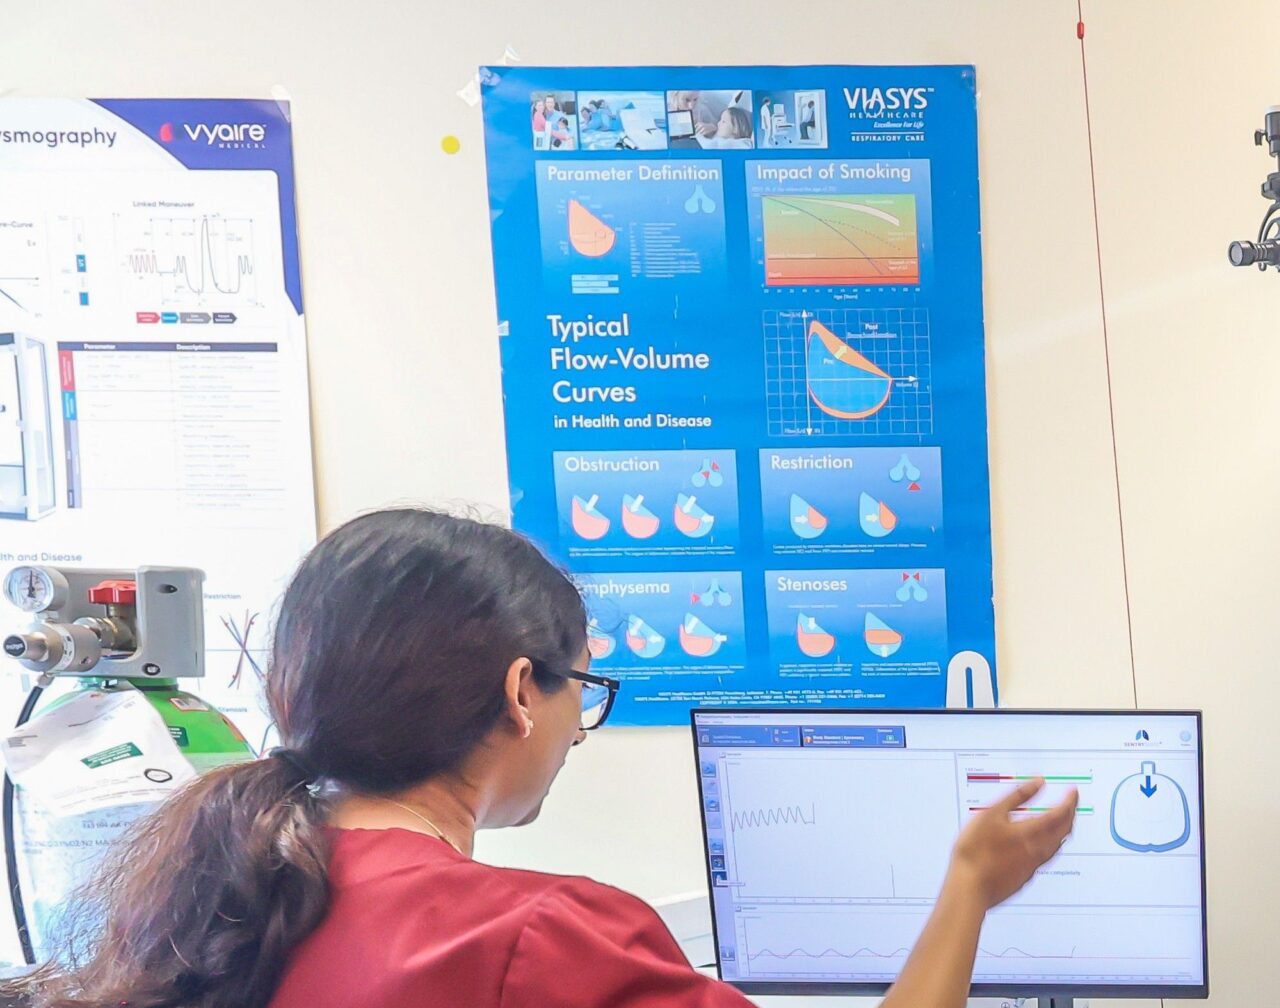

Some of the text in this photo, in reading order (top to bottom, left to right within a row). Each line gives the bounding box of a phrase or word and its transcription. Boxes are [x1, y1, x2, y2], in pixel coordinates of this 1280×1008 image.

[0, 127, 117, 148] smography
[547, 164, 719, 182] Parameter Definition
[757, 163, 911, 183] Impact of Smoking
[546, 313, 630, 342] Typical
[176, 343, 211, 351] Description
[550, 346, 710, 371] Flow-Volume
[552, 380, 637, 403] Curves
[554, 413, 712, 429] in Health and Disease
[564, 456, 660, 472] Obstruction
[771, 454, 854, 470] Restriction
[17, 552, 38, 561] and
[41, 552, 83, 561] Disease
[582, 578, 671, 598] mphysema
[777, 576, 848, 592] Stenoses
